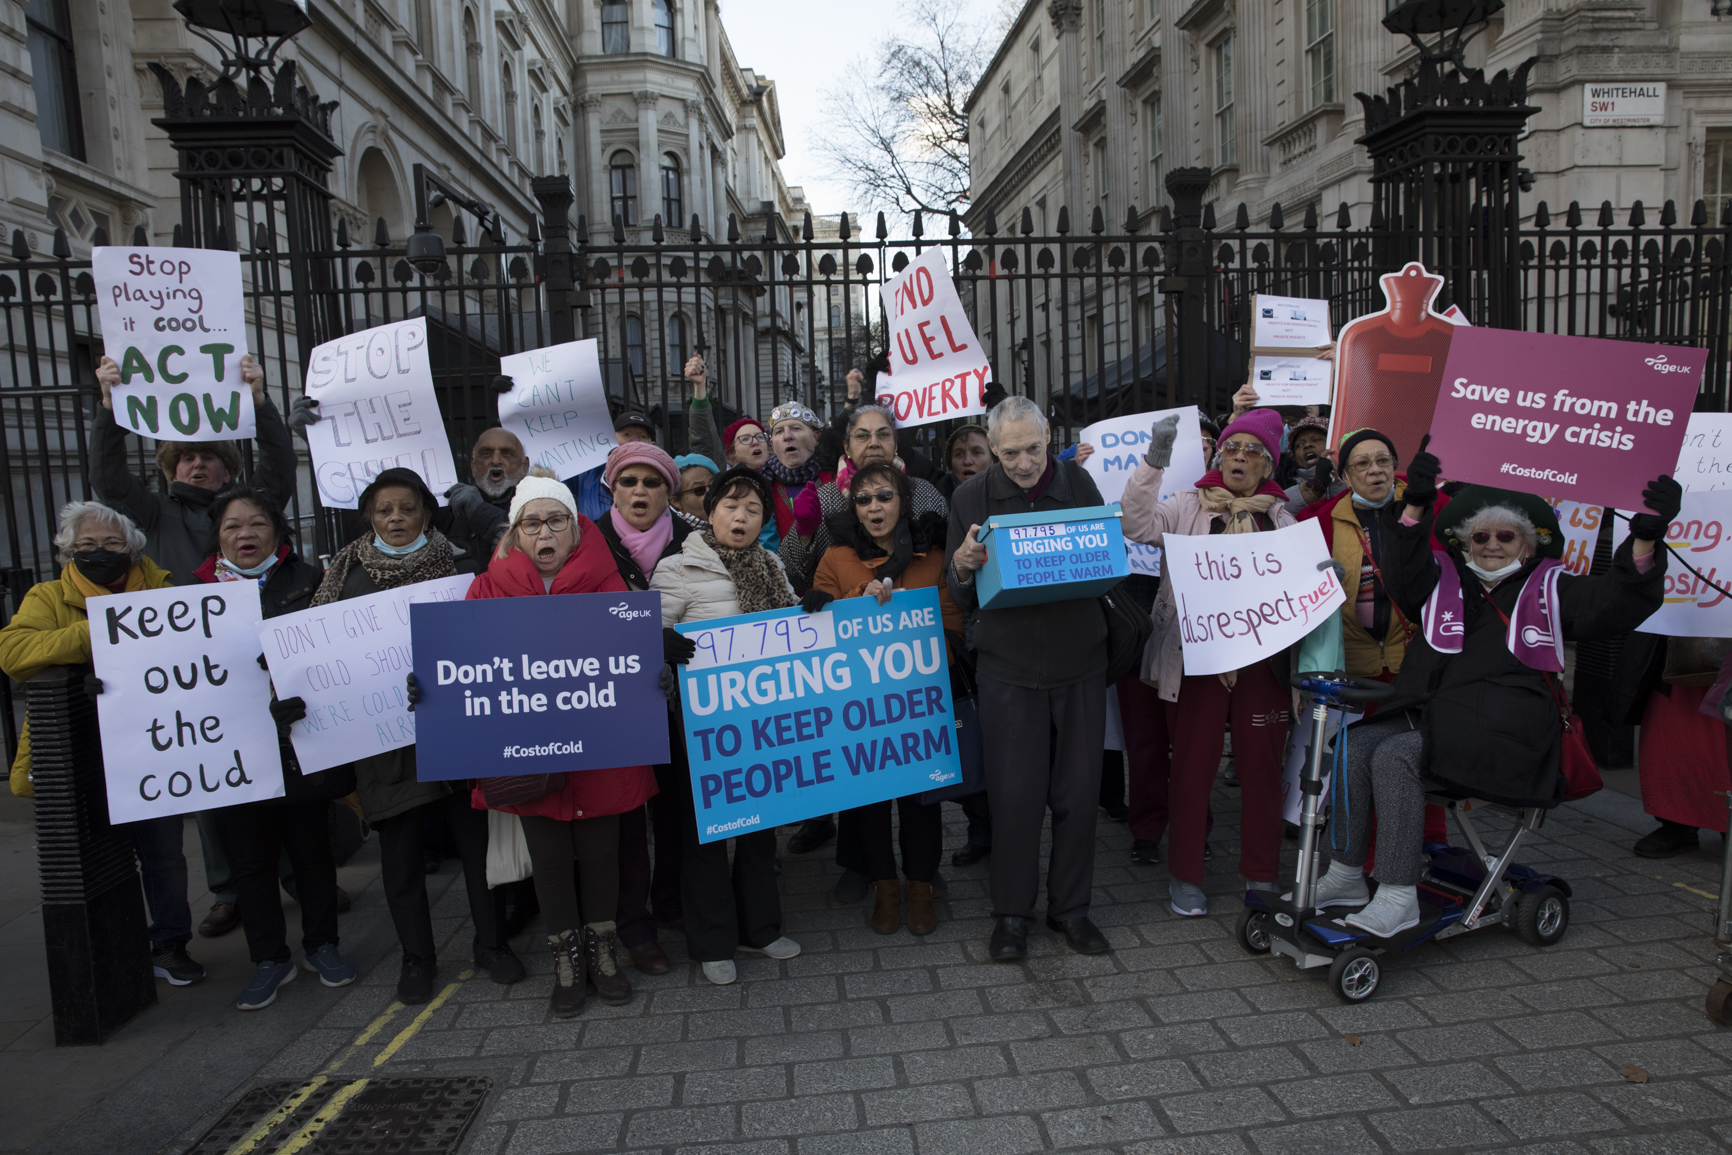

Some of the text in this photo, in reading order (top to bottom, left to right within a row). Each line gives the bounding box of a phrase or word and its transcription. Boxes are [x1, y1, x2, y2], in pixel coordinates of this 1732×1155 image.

[1590, 101, 1615, 112] SW1
[1591, 87, 1659, 98] WHITEHALL
[128, 253, 191, 284] Stop
[112, 282, 203, 314] playing
[122, 317, 135, 332] it
[120, 343, 235, 385] ACT
[311, 324, 425, 388] STOP
[528, 351, 553, 375] WE
[517, 380, 575, 408] CAN'T
[1451, 377, 1674, 426] Save us from the
[126, 391, 240, 436] NOW
[318, 390, 422, 447] THE
[524, 410, 578, 438] KEEP
[1470, 412, 1635, 451] energy crisis
[1500, 462, 1578, 485] #CostofCold
[1011, 533, 1108, 555] URGING YOU
[1013, 522, 1105, 538] 97.795 OF US ARE
[1015, 550, 1111, 570] TO KEEP OLDER
[1017, 564, 1114, 585] PEOPLE WARM
[1194, 551, 1282, 581] this is
[105, 594, 226, 645] Keep
[273, 617, 331, 660] DON'T
[342, 605, 383, 639] GIVE
[696, 607, 936, 664] 97.795 OF US ARE
[144, 655, 228, 694] out
[305, 659, 351, 692] COLD
[436, 654, 641, 685] Don't leave us
[687, 636, 942, 716] URGING YOU
[300, 685, 405, 734] WE'RE COLD
[464, 681, 616, 716] in the cold
[145, 710, 224, 751] the
[693, 685, 947, 761] TO KEEP OLDER
[503, 741, 583, 758] #CostofCold
[139, 749, 253, 801] cold
[699, 724, 952, 809] PEOPLE WARM
[706, 814, 761, 836] #CostofCold
